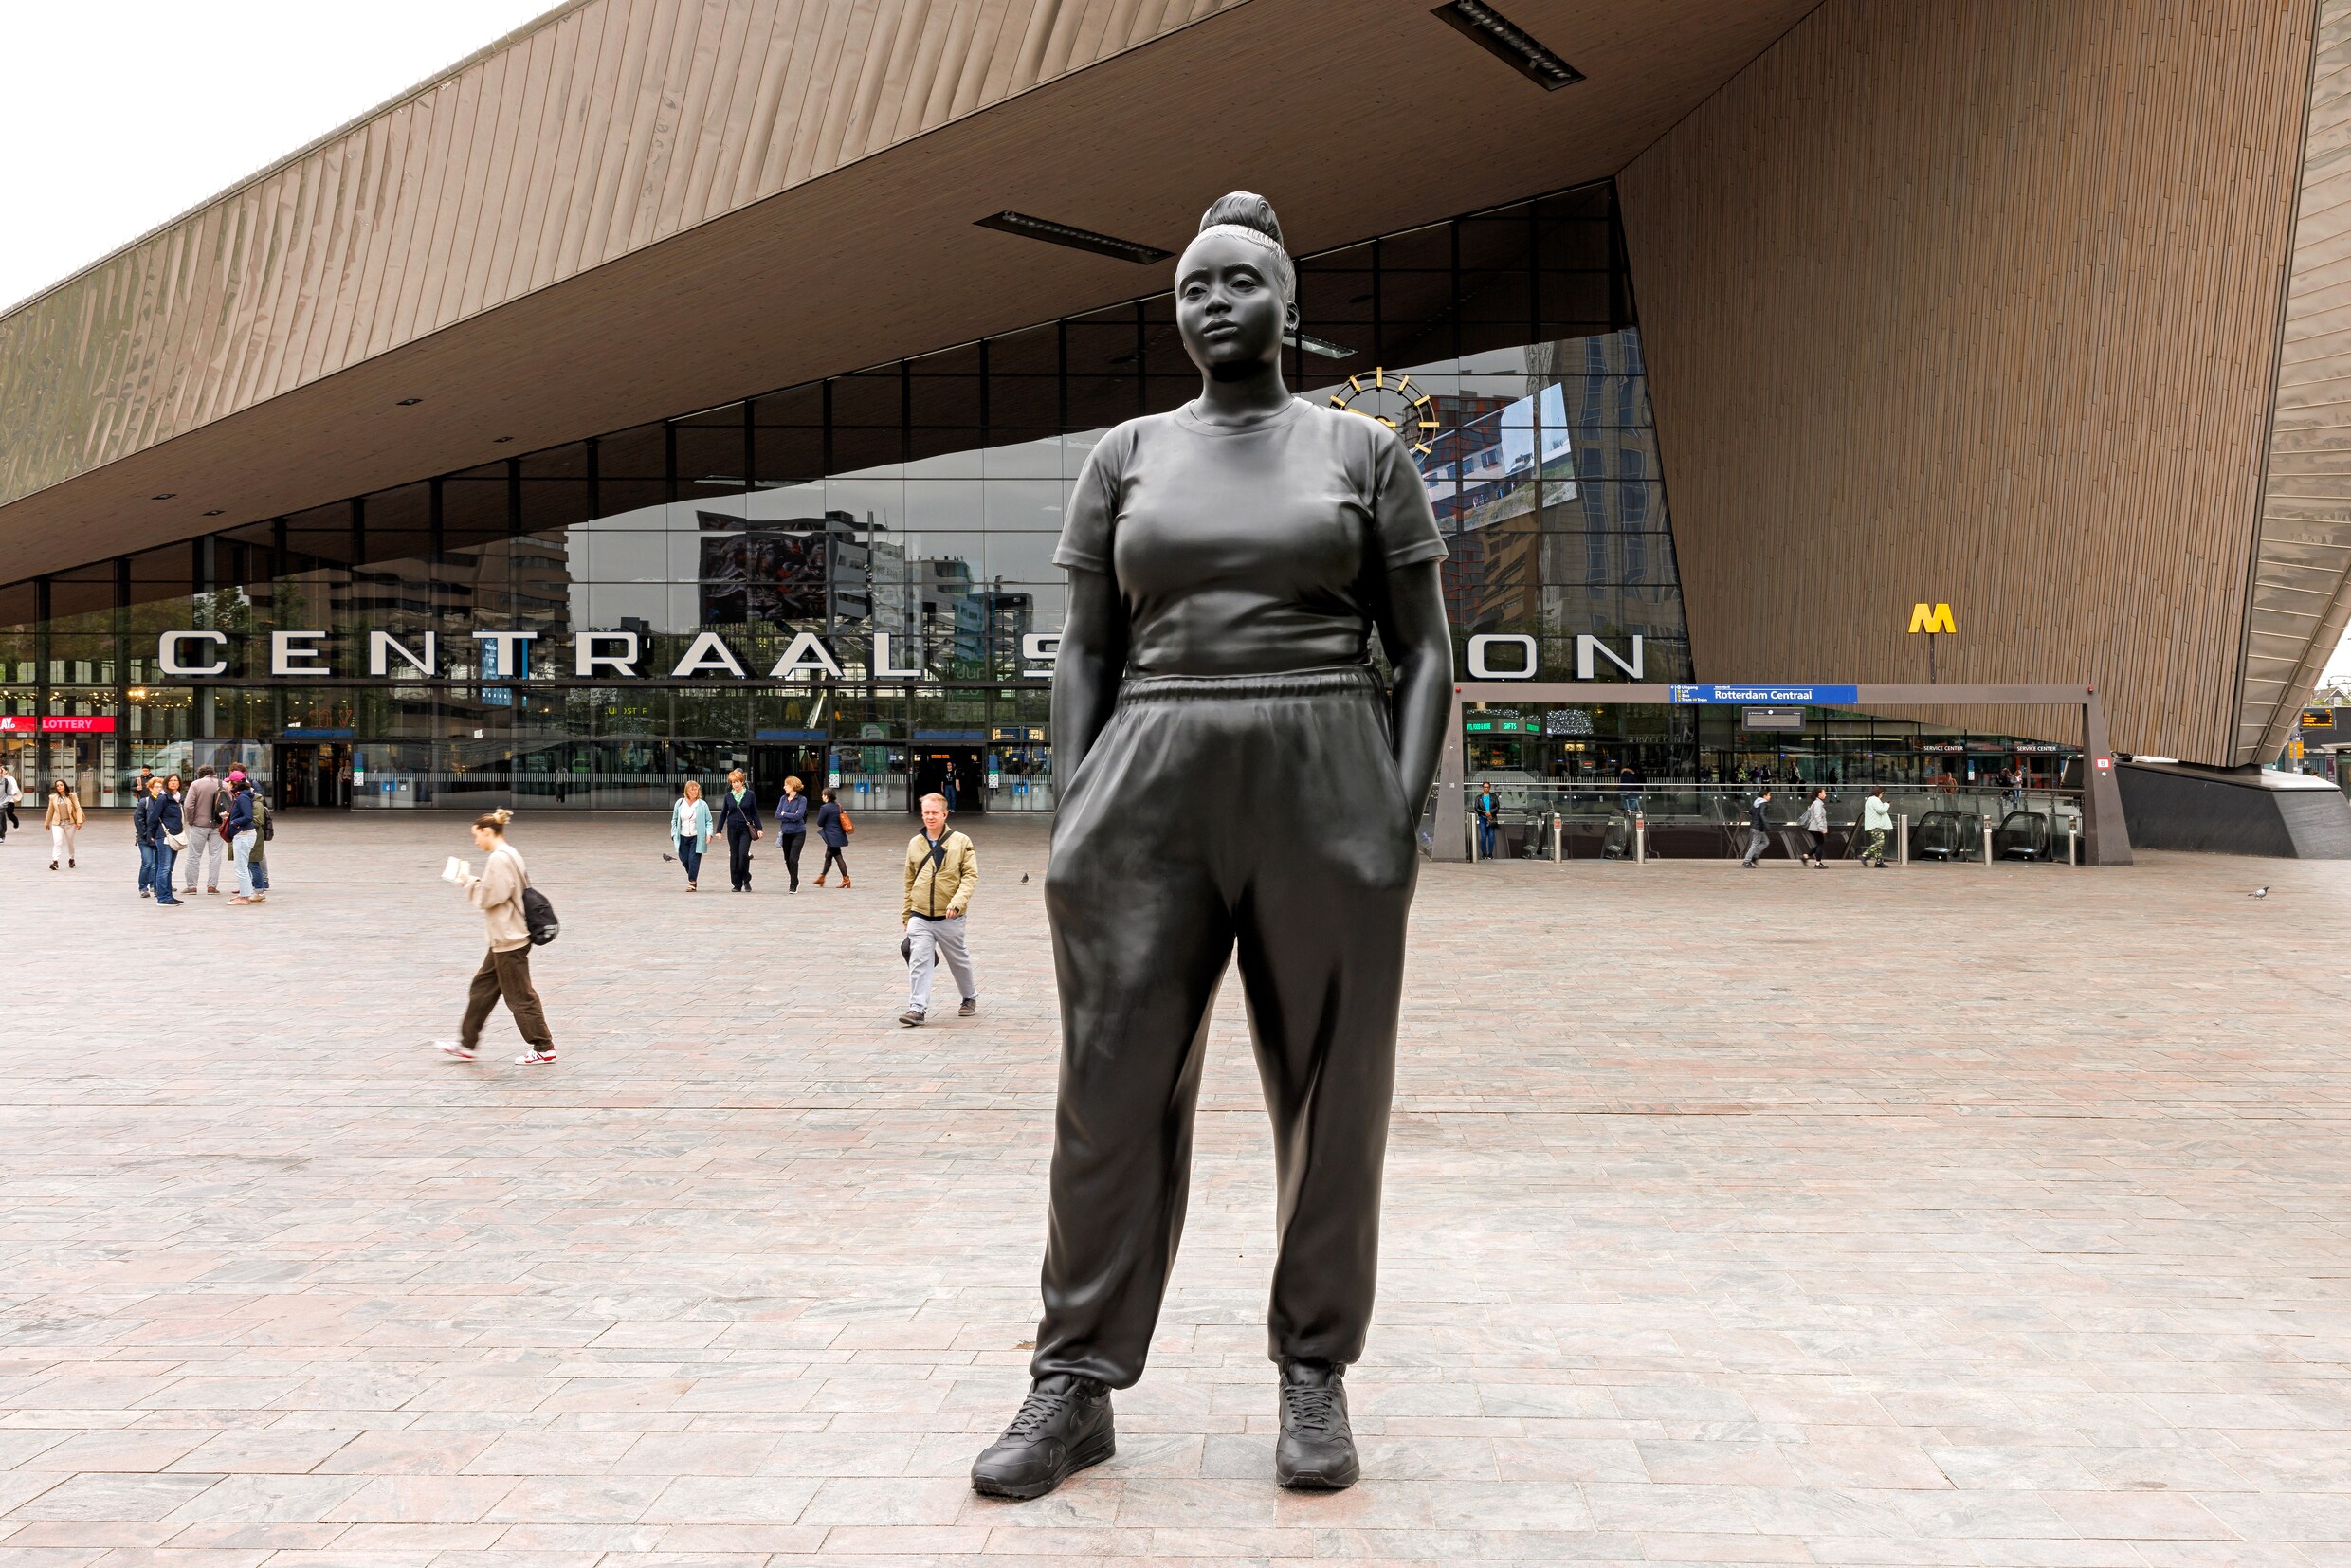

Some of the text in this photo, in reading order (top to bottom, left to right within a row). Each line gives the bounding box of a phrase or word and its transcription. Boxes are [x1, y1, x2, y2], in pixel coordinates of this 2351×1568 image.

[1907, 603, 1957, 634] M
[158, 630, 922, 677] CENTRAAL
[1715, 690, 1813, 700] Rotterdam Centraal
[43, 720, 92, 729] LOTTERY
